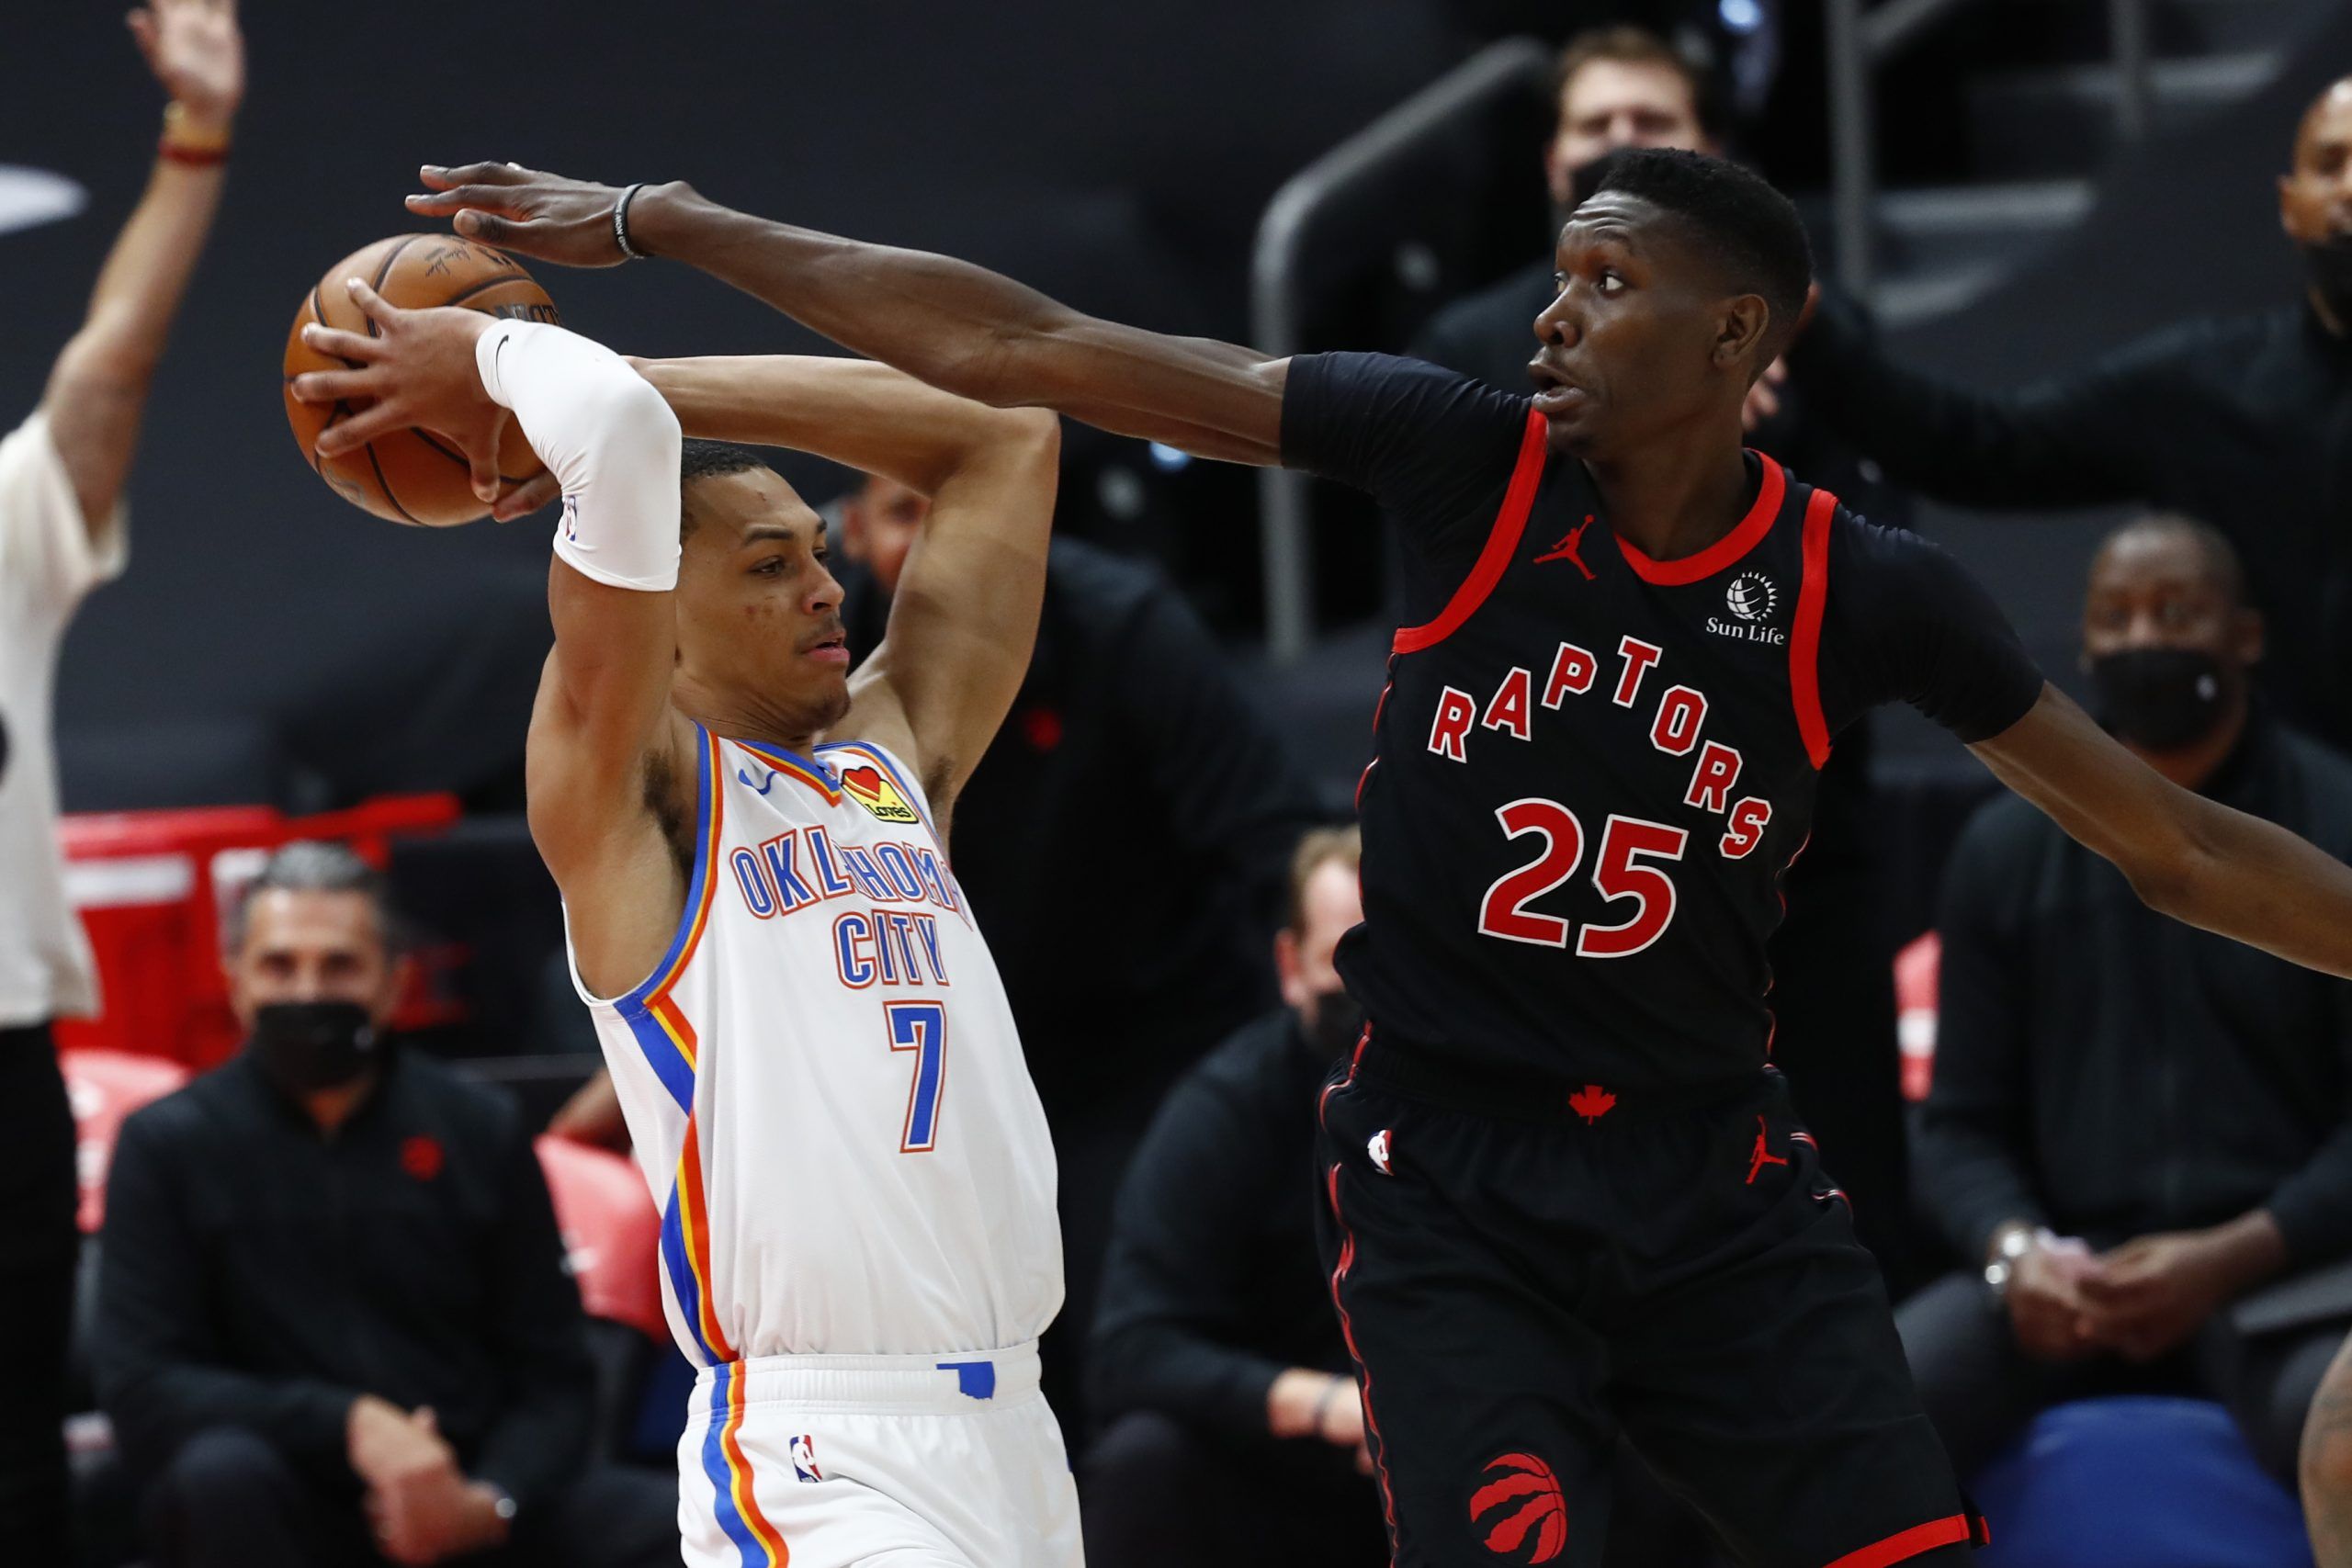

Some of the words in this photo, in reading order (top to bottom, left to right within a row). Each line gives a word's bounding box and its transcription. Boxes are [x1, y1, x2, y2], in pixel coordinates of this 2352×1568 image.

[1706, 616, 1744, 638] Sun
[1747, 625, 1785, 645] Life
[1428, 635, 1772, 859] RAPTORS
[729, 824, 974, 932] OKLHOM
[1477, 797, 1690, 958] 25
[832, 908, 950, 989] CITY
[883, 999, 946, 1154] 7
